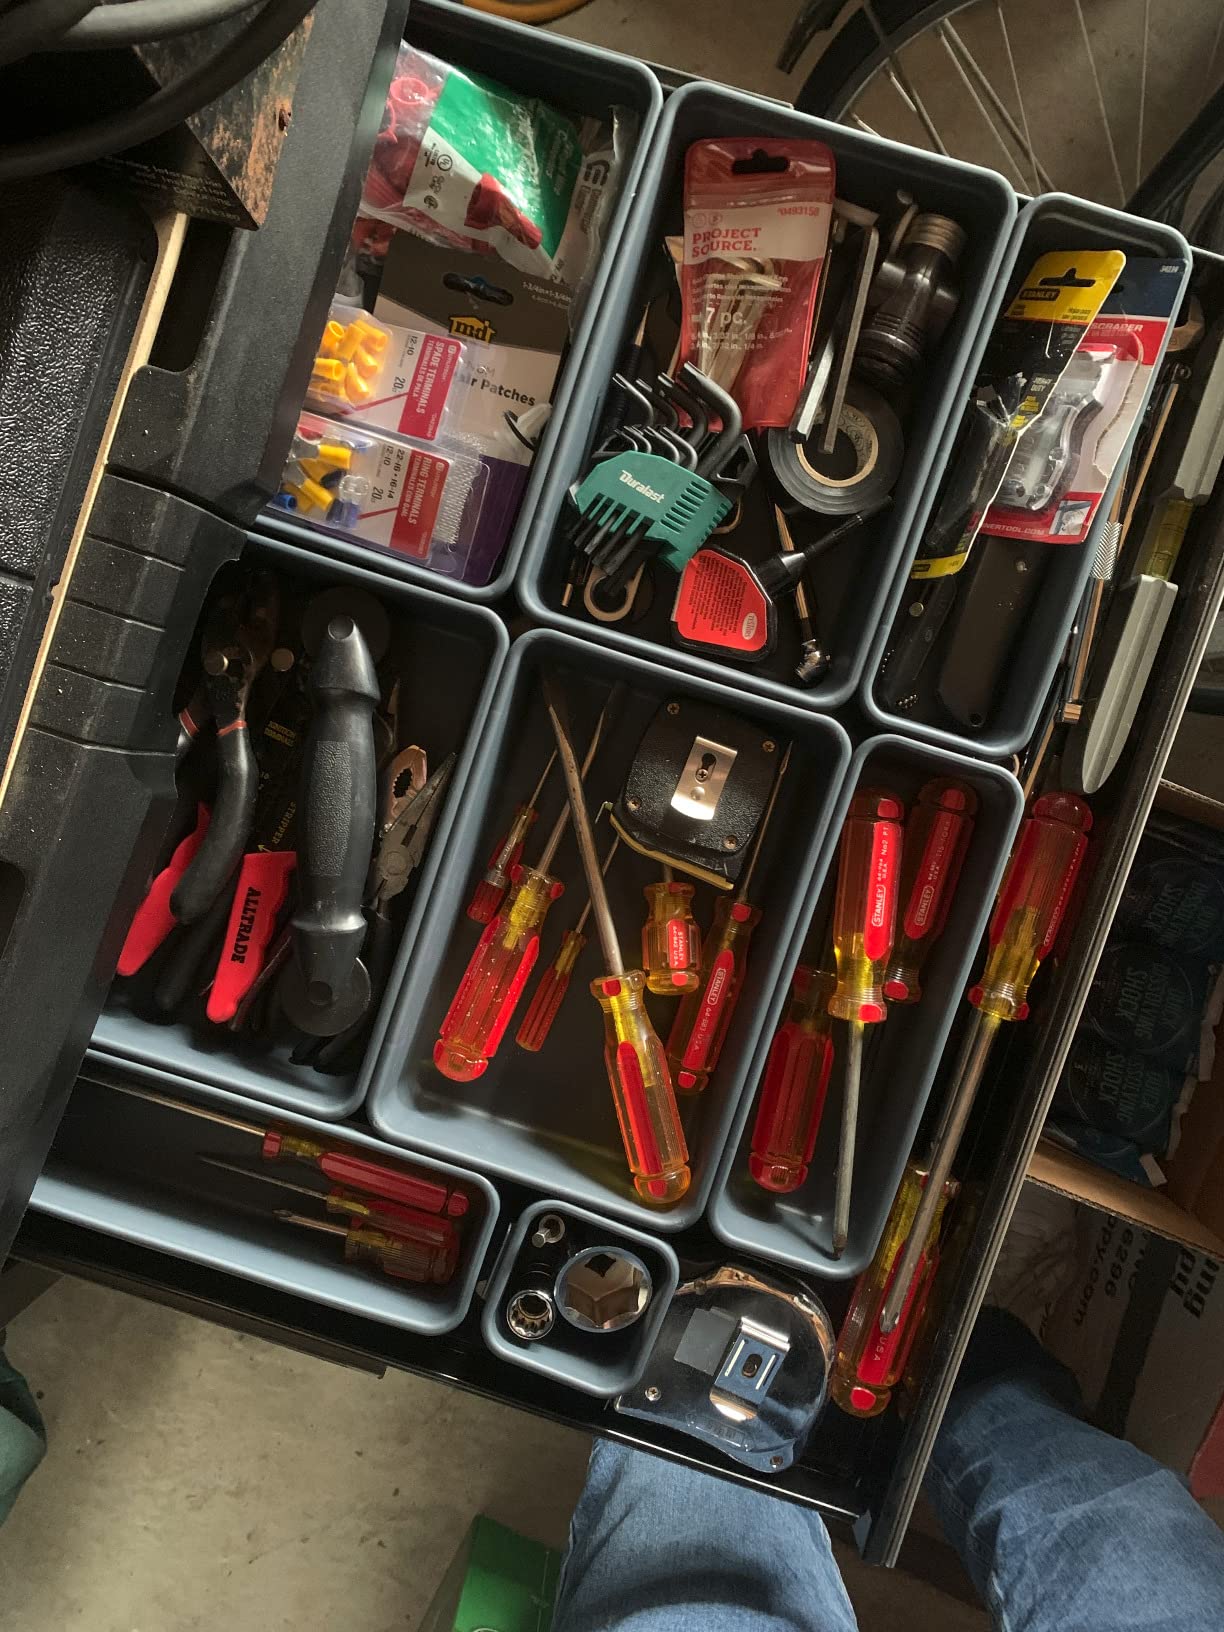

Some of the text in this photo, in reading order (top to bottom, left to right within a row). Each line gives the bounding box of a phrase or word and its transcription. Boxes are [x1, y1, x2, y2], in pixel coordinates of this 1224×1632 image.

[692, 228, 762, 246] PROJECT
[692, 240, 757, 258] SOURCE.
[720, 311, 747, 327] pc.
[408, 336, 418, 355] 12-10
[431, 342, 443, 366] SPADE
[394, 377, 406, 388] 20
[417, 370, 436, 413] TERMINALS
[480, 377, 536, 407] Patches
[383, 446, 393, 465] 12-10
[420, 458, 431, 478] RING
[388, 449, 404, 498] 22-16 16-14
[618, 470, 665, 504] Duralast
[372, 487, 383, 499] 20
[409, 480, 426, 524] TERMINALS
[272, 801, 296, 844] STRIPPER
[874, 888, 883, 922] STANLEY
[916, 888, 932, 923] STANLEY
[1142, 884, 1182, 929] SHOCK
[230, 886, 261, 966] ALLTRADE
[709, 971, 723, 1002] STANLEY
[1114, 968, 1147, 1023] SHOCK
[1098, 1053, 1125, 1106] SHOCK
[873, 1337, 887, 1360] USA
